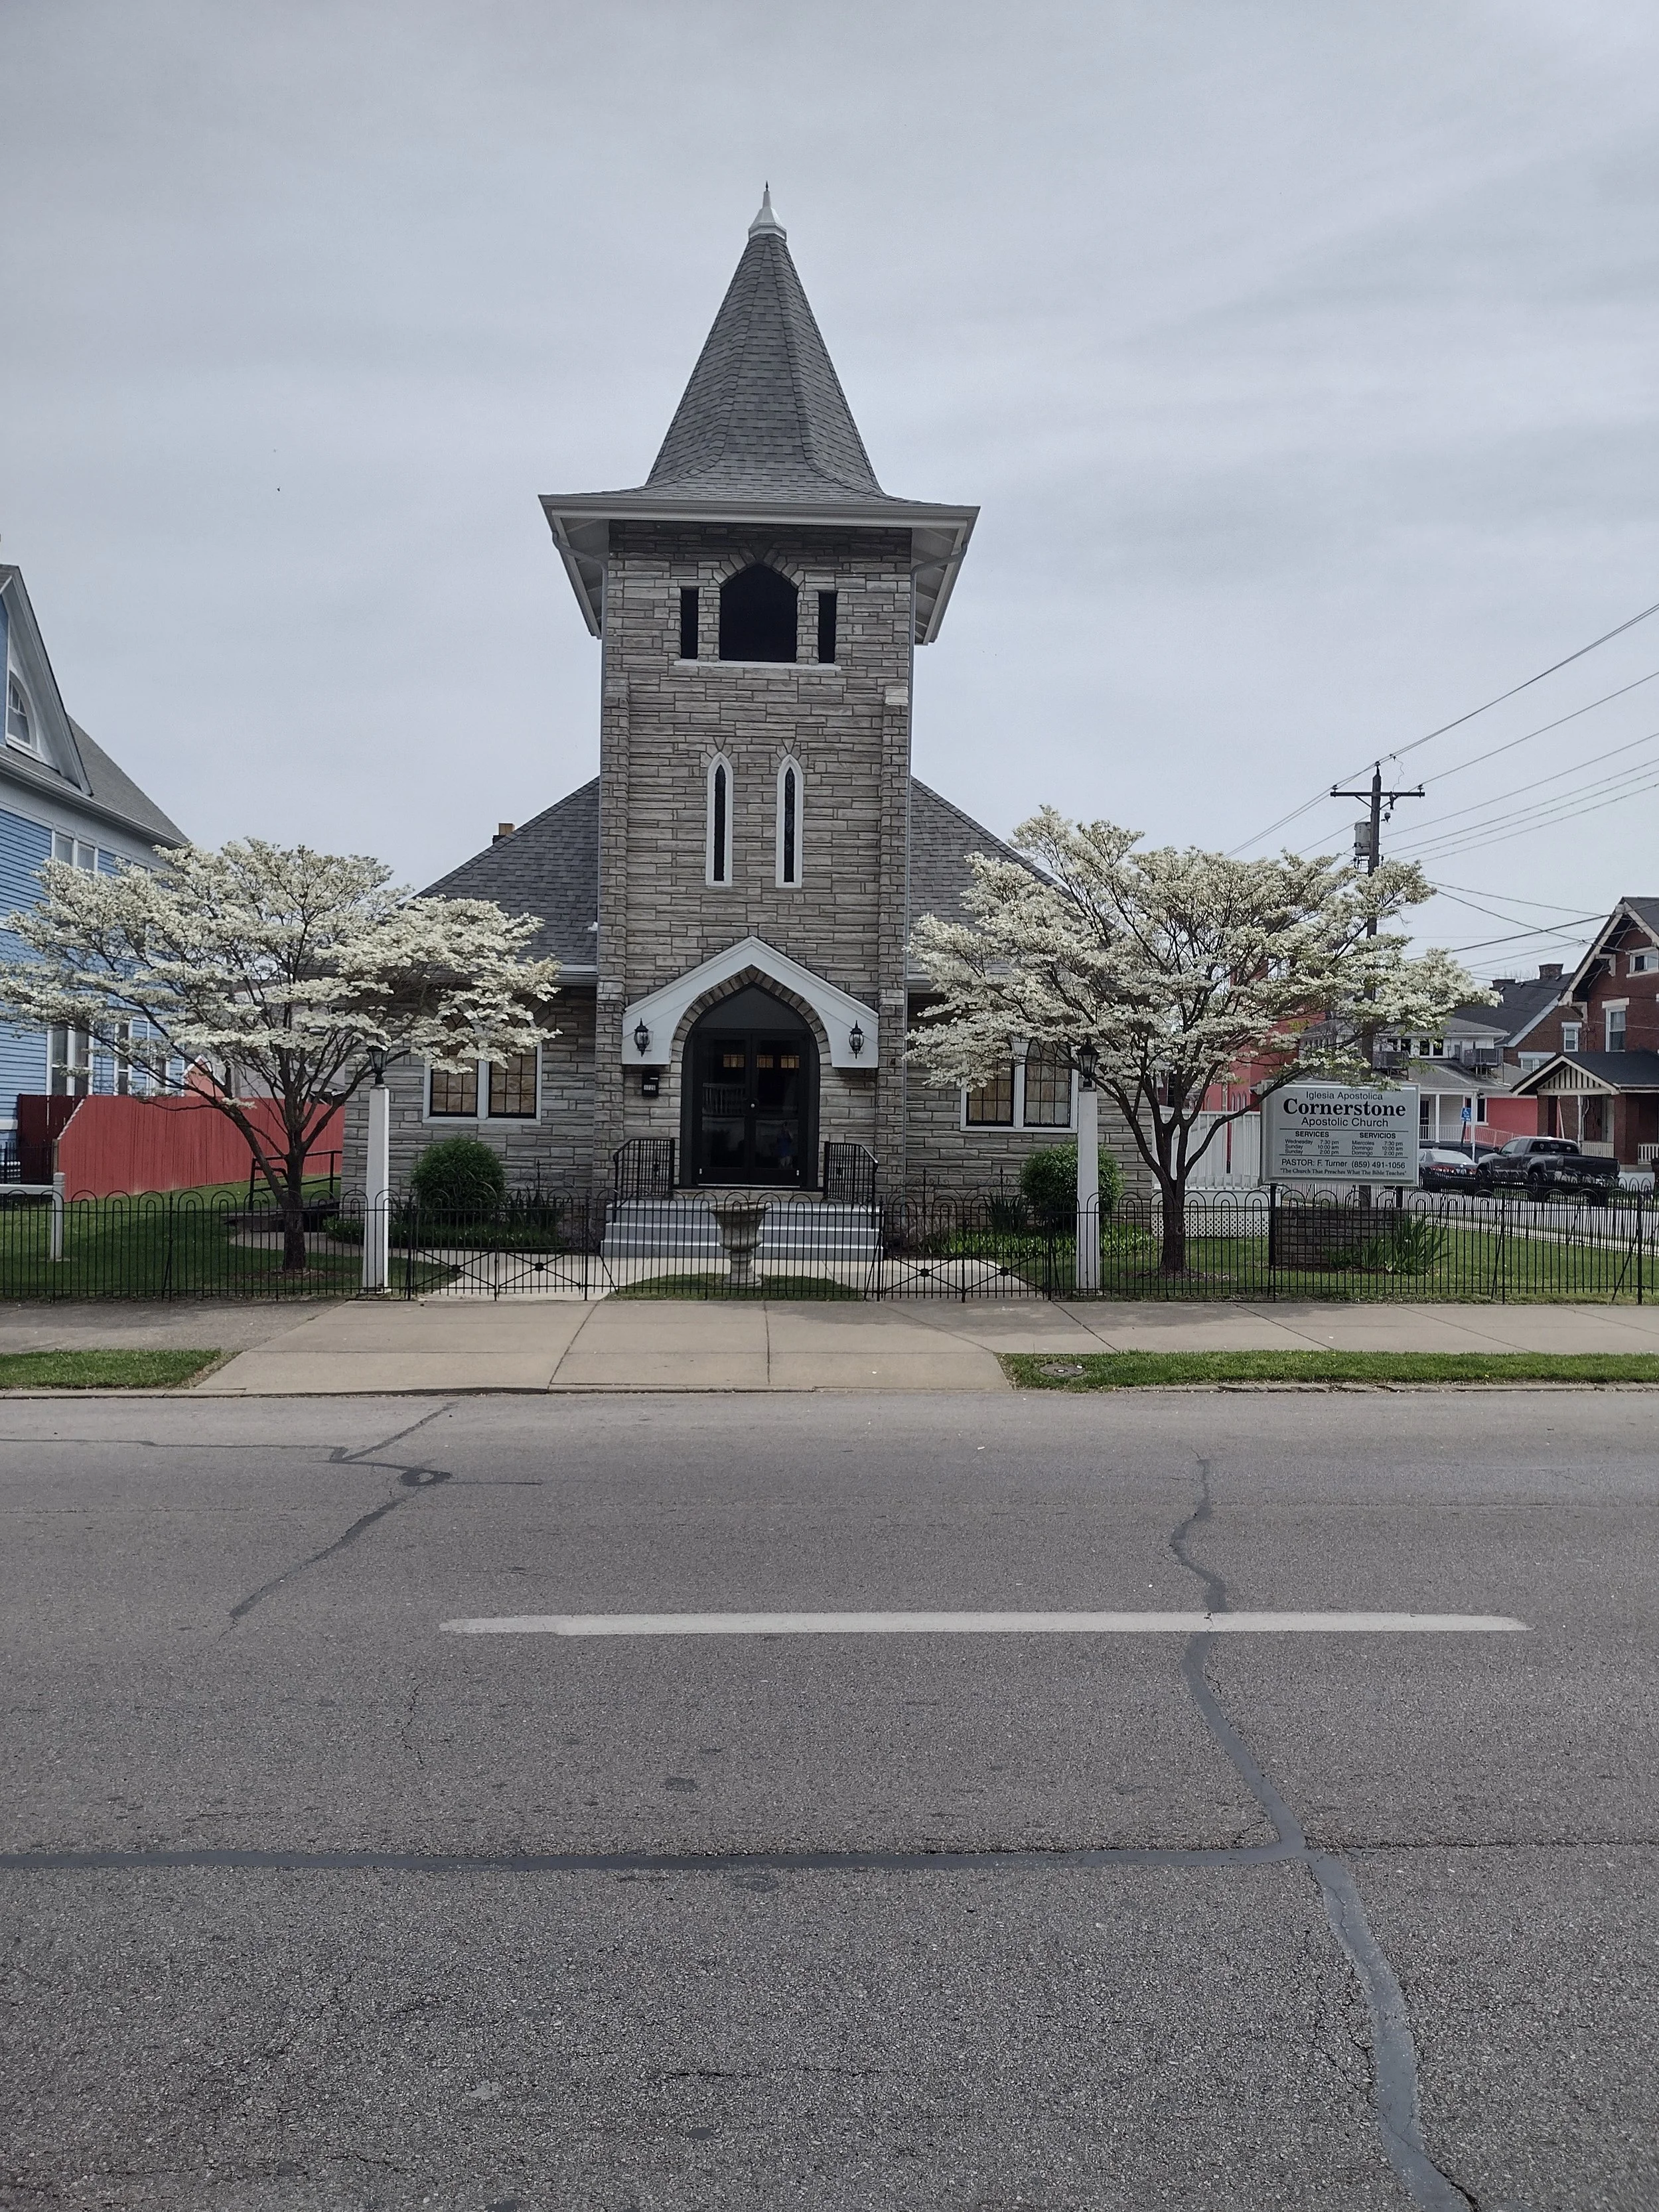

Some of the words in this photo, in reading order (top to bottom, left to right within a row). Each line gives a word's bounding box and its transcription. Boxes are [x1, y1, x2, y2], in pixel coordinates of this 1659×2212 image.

[1306, 1091, 1334, 1100] Iglesia
[1337, 1092, 1383, 1101] Apostolica
[1283, 1098, 1406, 1116] Cornerstone
[1301, 1117, 1348, 1128] Apostolic
[1351, 1118, 1389, 1127] Church
